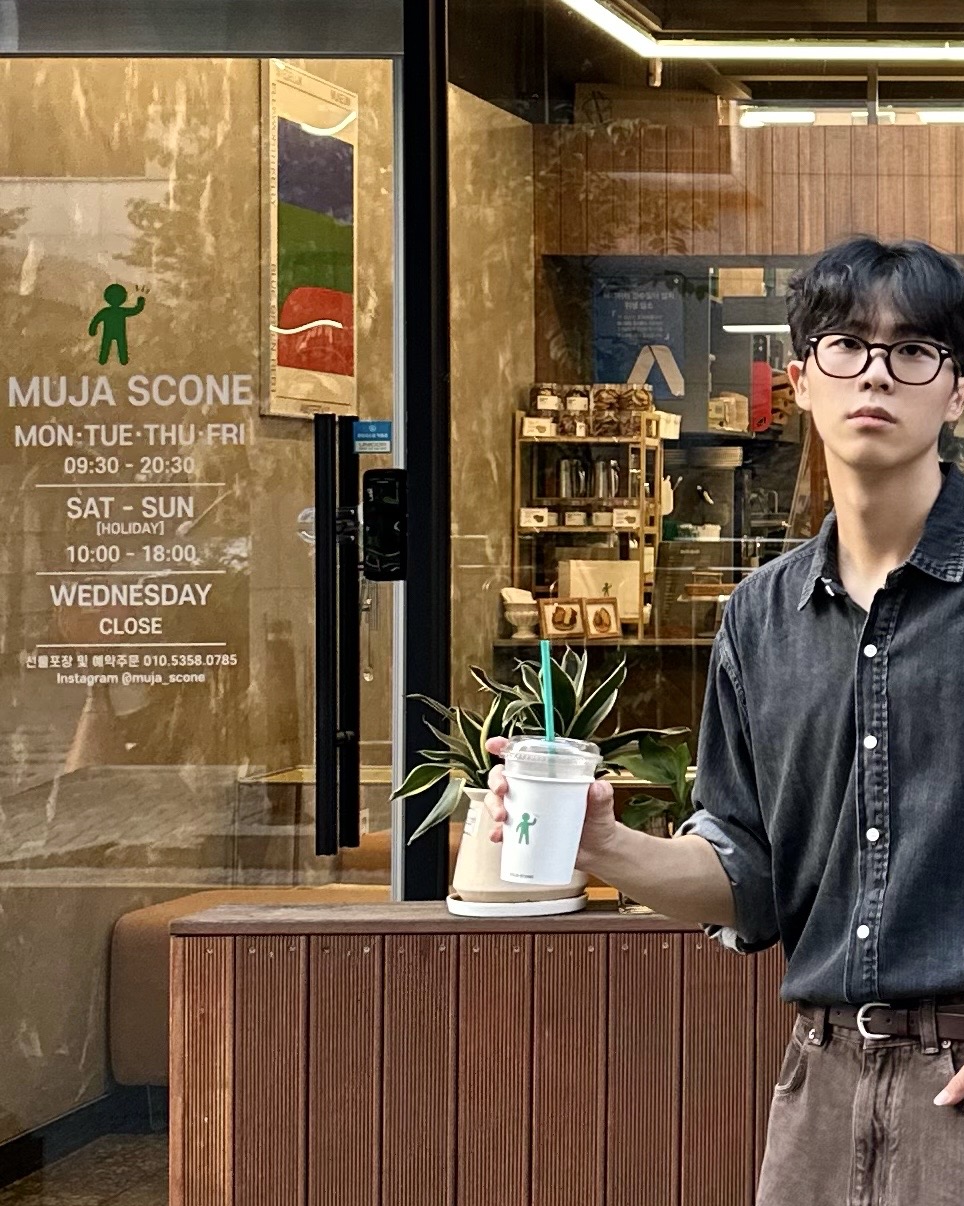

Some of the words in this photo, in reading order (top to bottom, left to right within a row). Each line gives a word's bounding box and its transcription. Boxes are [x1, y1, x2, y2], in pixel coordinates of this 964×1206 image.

[8, 375, 117, 408] MUJA
[128, 373, 253, 407] SCONE
[64, 456, 119, 474] 09:30
[140, 456, 195, 474] 20:30
[66, 496, 115, 519] SAT
[141, 496, 195, 519] SUN
[96, 520, 165, 536] [HOLIDAY]
[66, 545, 120, 563] 10:00
[142, 544, 196, 562] 18:00
[50, 583, 213, 607] WEDNESDAY
[99, 617, 163, 635] CLOSE
[77, 655, 88, 669] 및
[92, 655, 140, 669] 예약주문
[143, 653, 238, 667] 010.5358.0785
[57, 673, 119, 686] Instagram
[122, 671, 206, 686] @muja_scone
